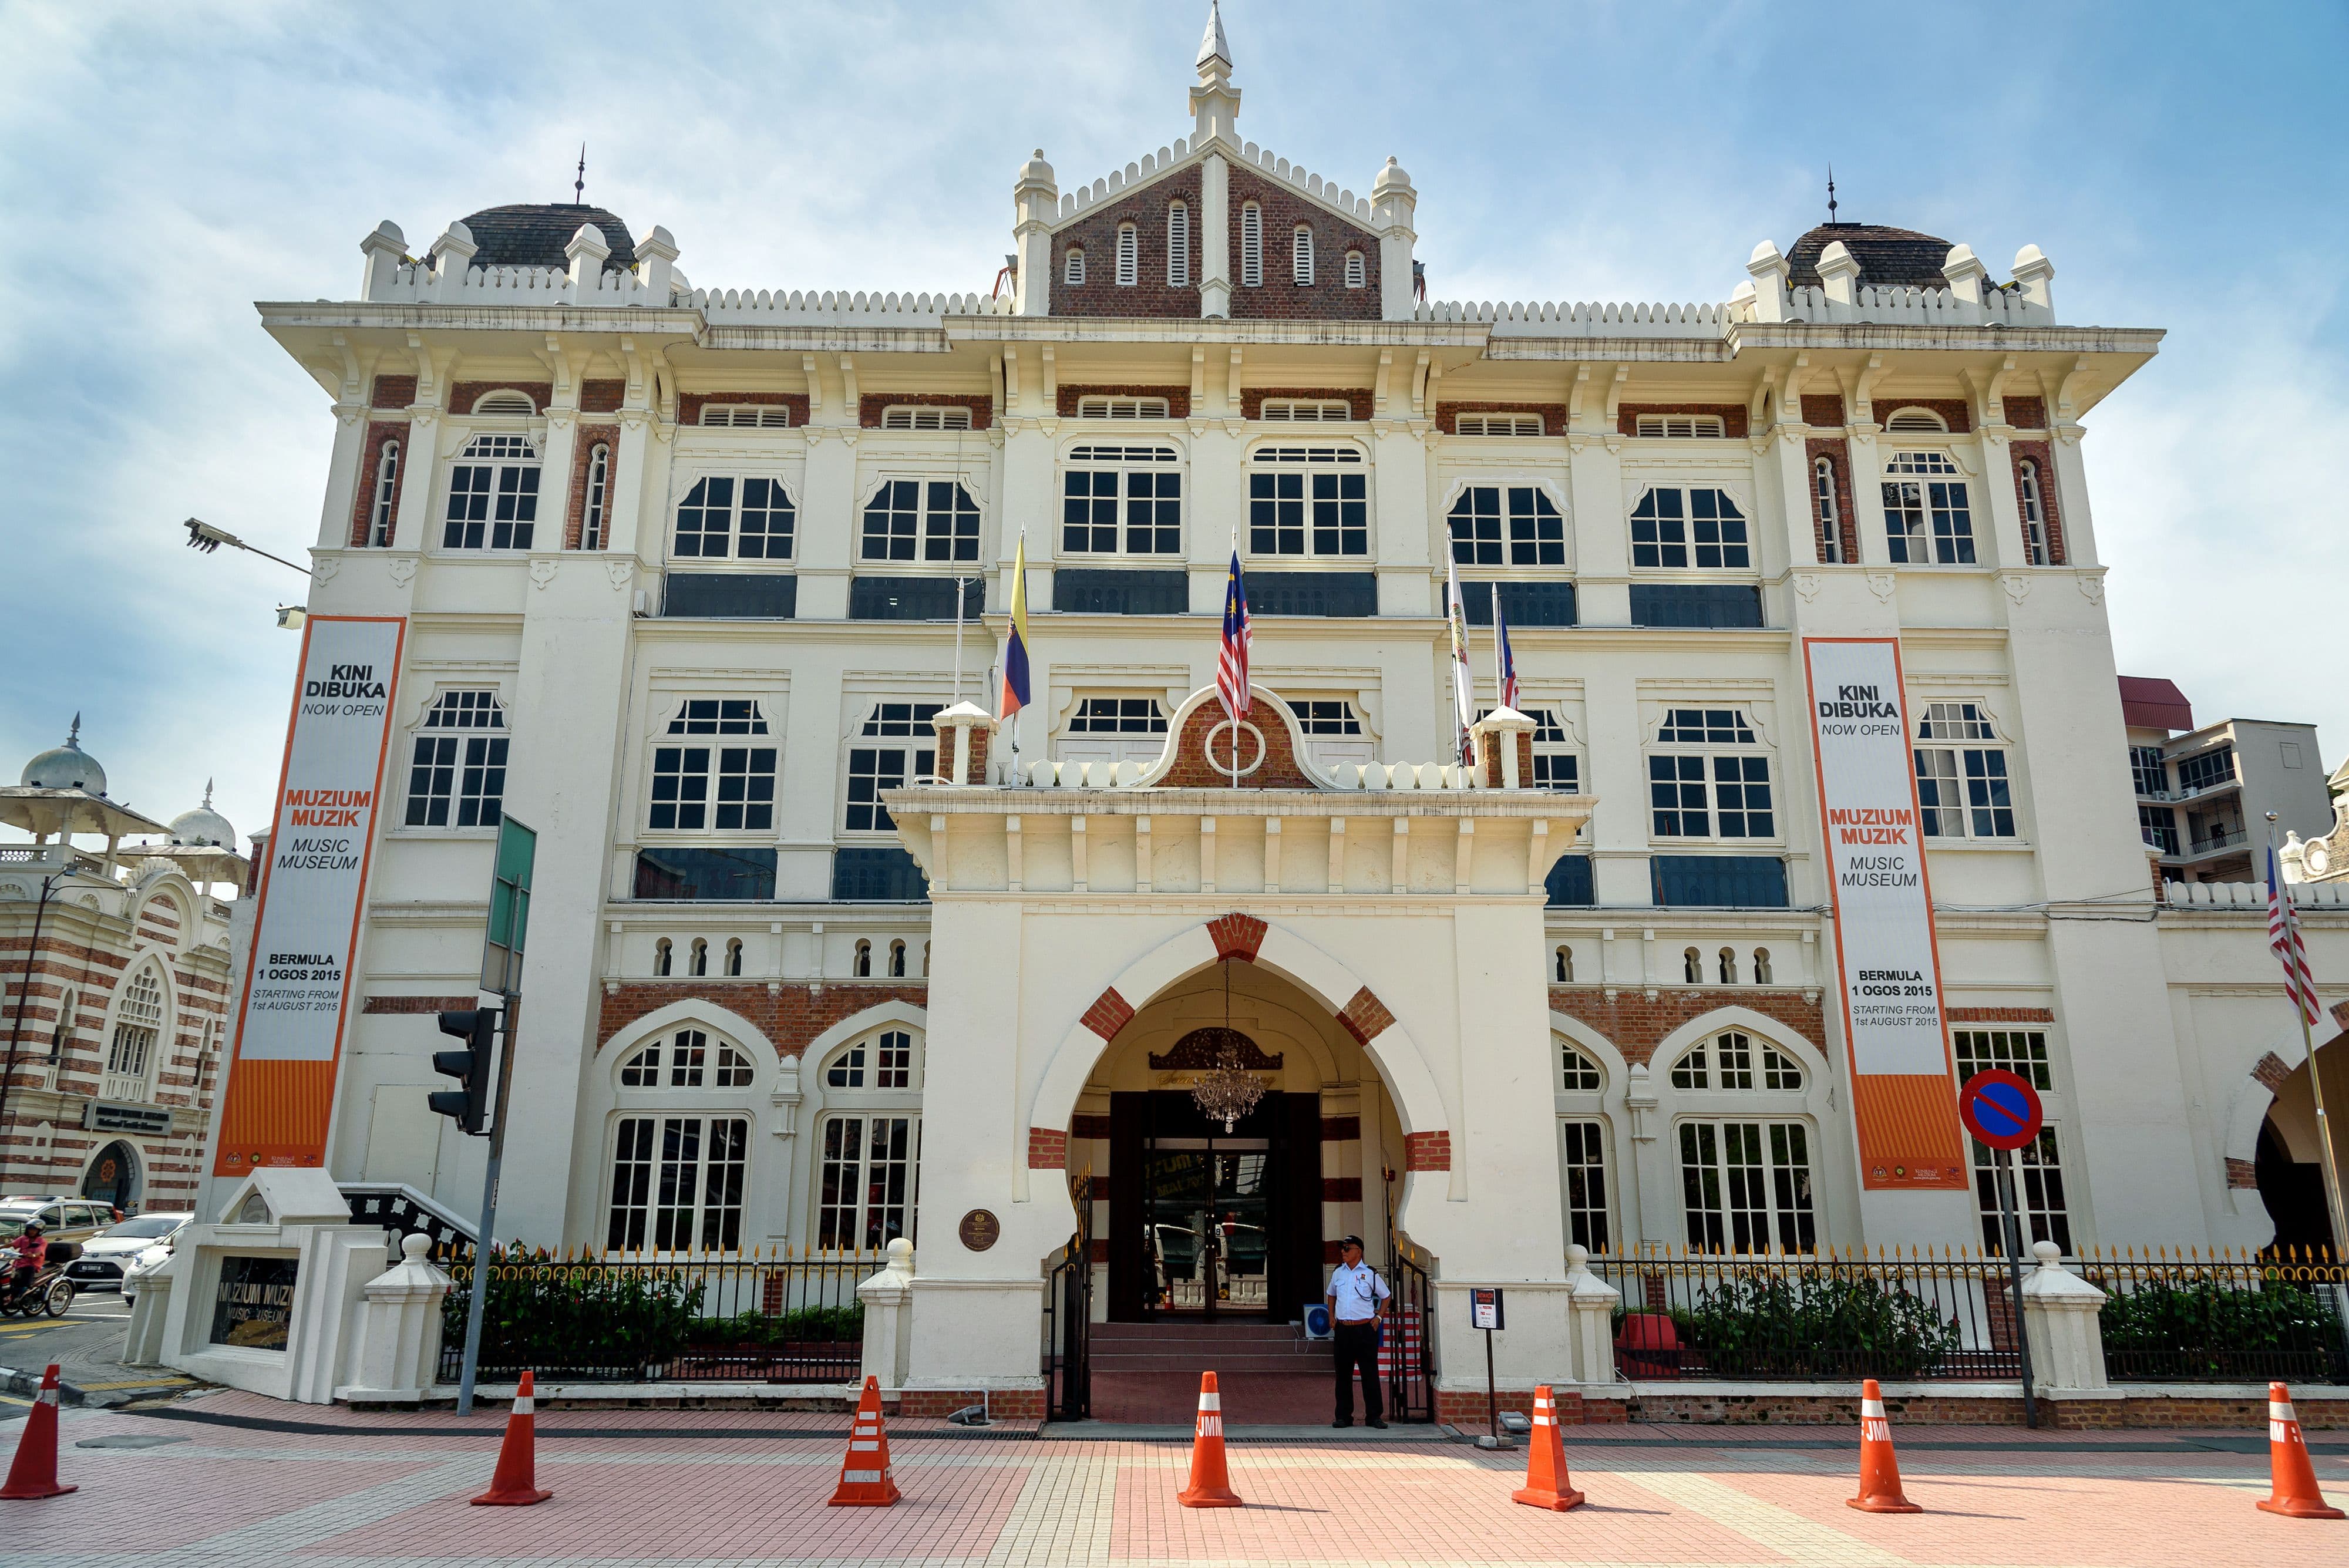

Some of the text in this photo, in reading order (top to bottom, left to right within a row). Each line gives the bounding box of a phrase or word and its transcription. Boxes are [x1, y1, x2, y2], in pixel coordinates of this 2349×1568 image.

[331, 664, 373, 681] KINI
[306, 681, 386, 698] DIBUKA
[1838, 685, 1879, 701] KINI
[302, 704, 384, 716] NOW OPEN
[1819, 702, 1899, 718] DIBUKA
[1822, 724, 1900, 736] NOW OPEN
[286, 790, 371, 807] MUZIUM
[291, 810, 360, 827] MUZIK
[1830, 809, 1912, 825] MUZIUM
[1840, 828, 1908, 844] MUZIK
[291, 838, 349, 853] MUSIC
[278, 854, 358, 870] MUSEUM
[1850, 856, 1904, 870] MUSIC
[1842, 873, 1917, 887] MUSEUM
[270, 954, 334, 965] BERMULA
[258, 968, 341, 981] 1 OGOS 2015
[1859, 970, 1923, 981] BERMULA
[253, 989, 339, 1000] STARTING FROM
[1852, 985, 1933, 997] 1 OGOS 2015
[253, 1002, 338, 1011] 1st AUGUST 2015
[1853, 1005, 1936, 1015] STARTING FROM
[1855, 1017, 1937, 1026] 1st AUGUST 2015
[219, 1283, 261, 1304] MUZIUM
[227, 1307, 287, 1323] MUSIC USEUM
[1199, 1416, 1223, 1437] JMM
